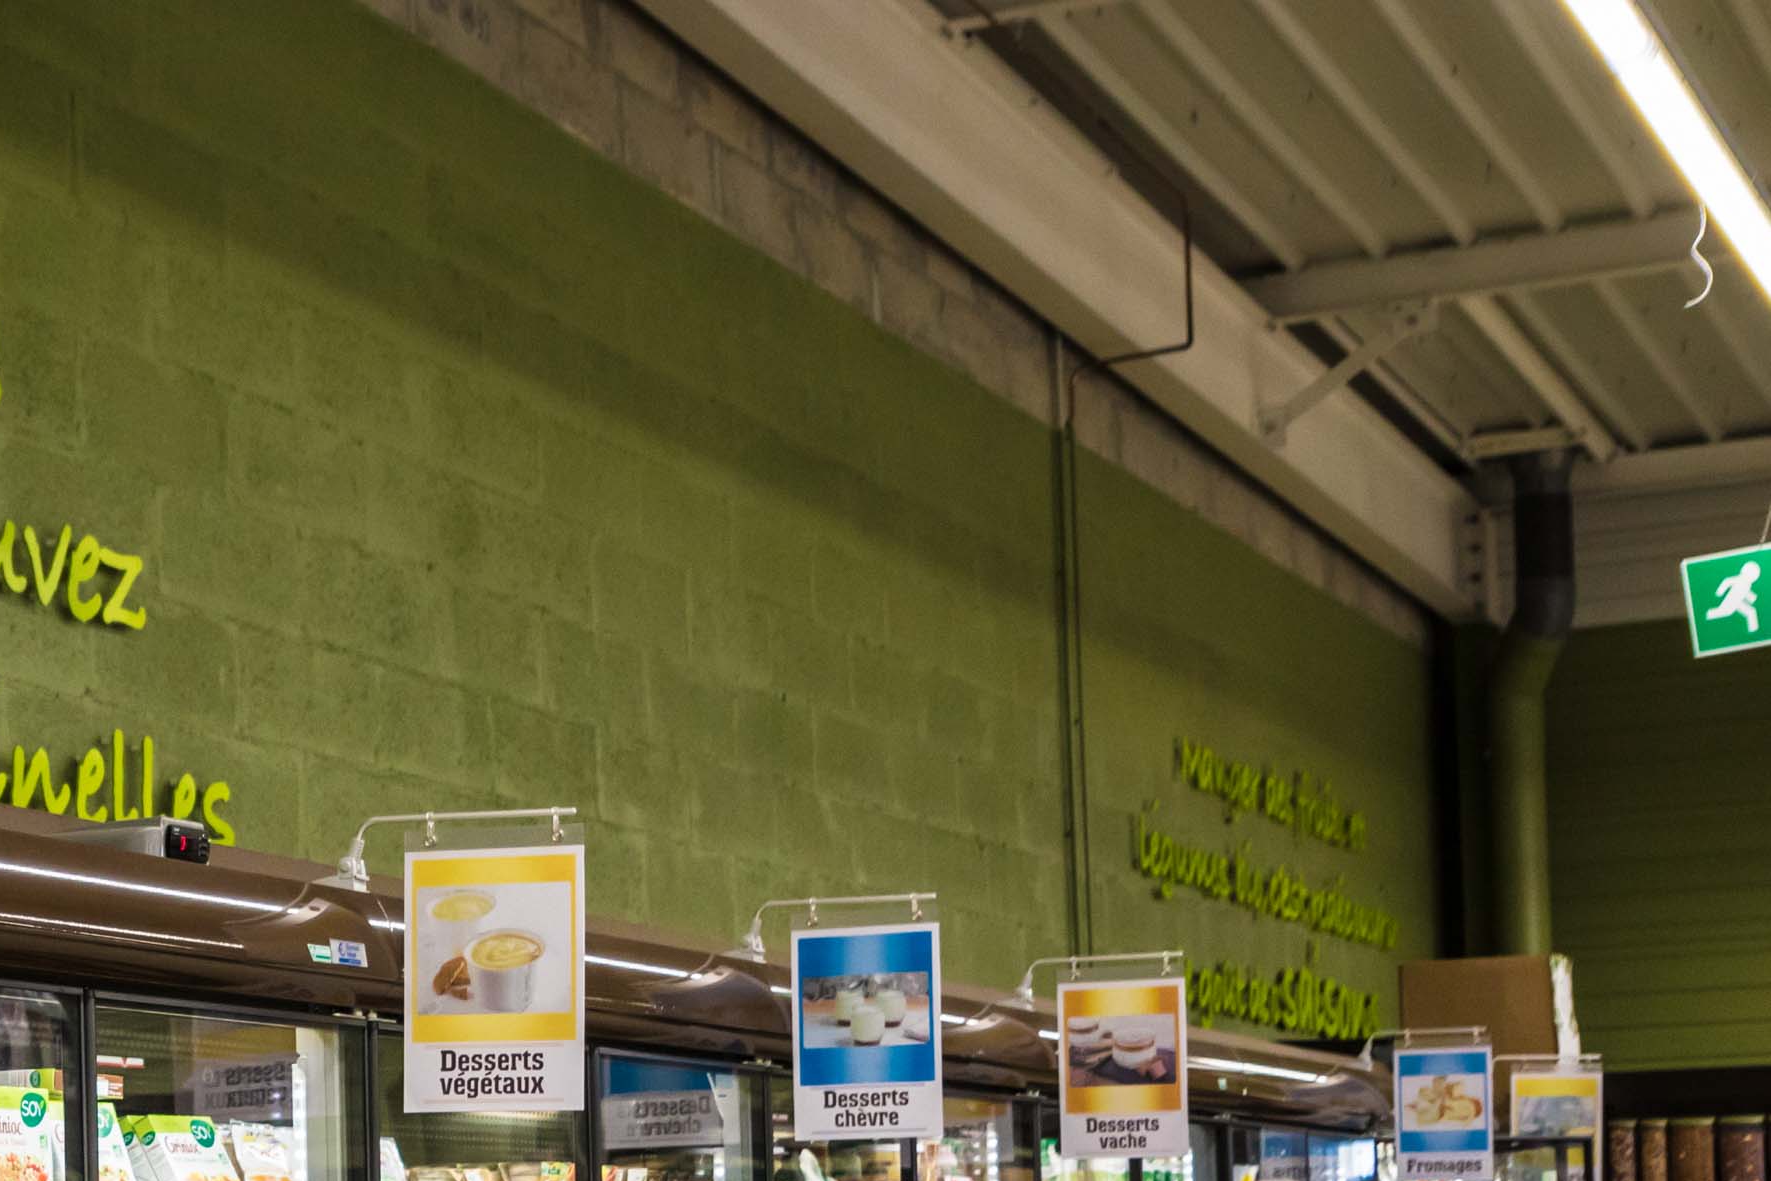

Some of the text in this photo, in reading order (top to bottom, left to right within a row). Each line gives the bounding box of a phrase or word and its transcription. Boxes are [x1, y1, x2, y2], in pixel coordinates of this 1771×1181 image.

[440, 1049, 545, 1073] Desserts
[440, 1071, 545, 1099] végétaux
[823, 1089, 909, 1109] Desserts
[21, 1100, 46, 1118] SOY
[834, 1107, 899, 1128] chèvre
[190, 1124, 214, 1140] SOY
[1086, 1117, 1160, 1134] Desserts
[1099, 1132, 1147, 1149] vache
[1406, 1157, 1482, 1175] Fromages
